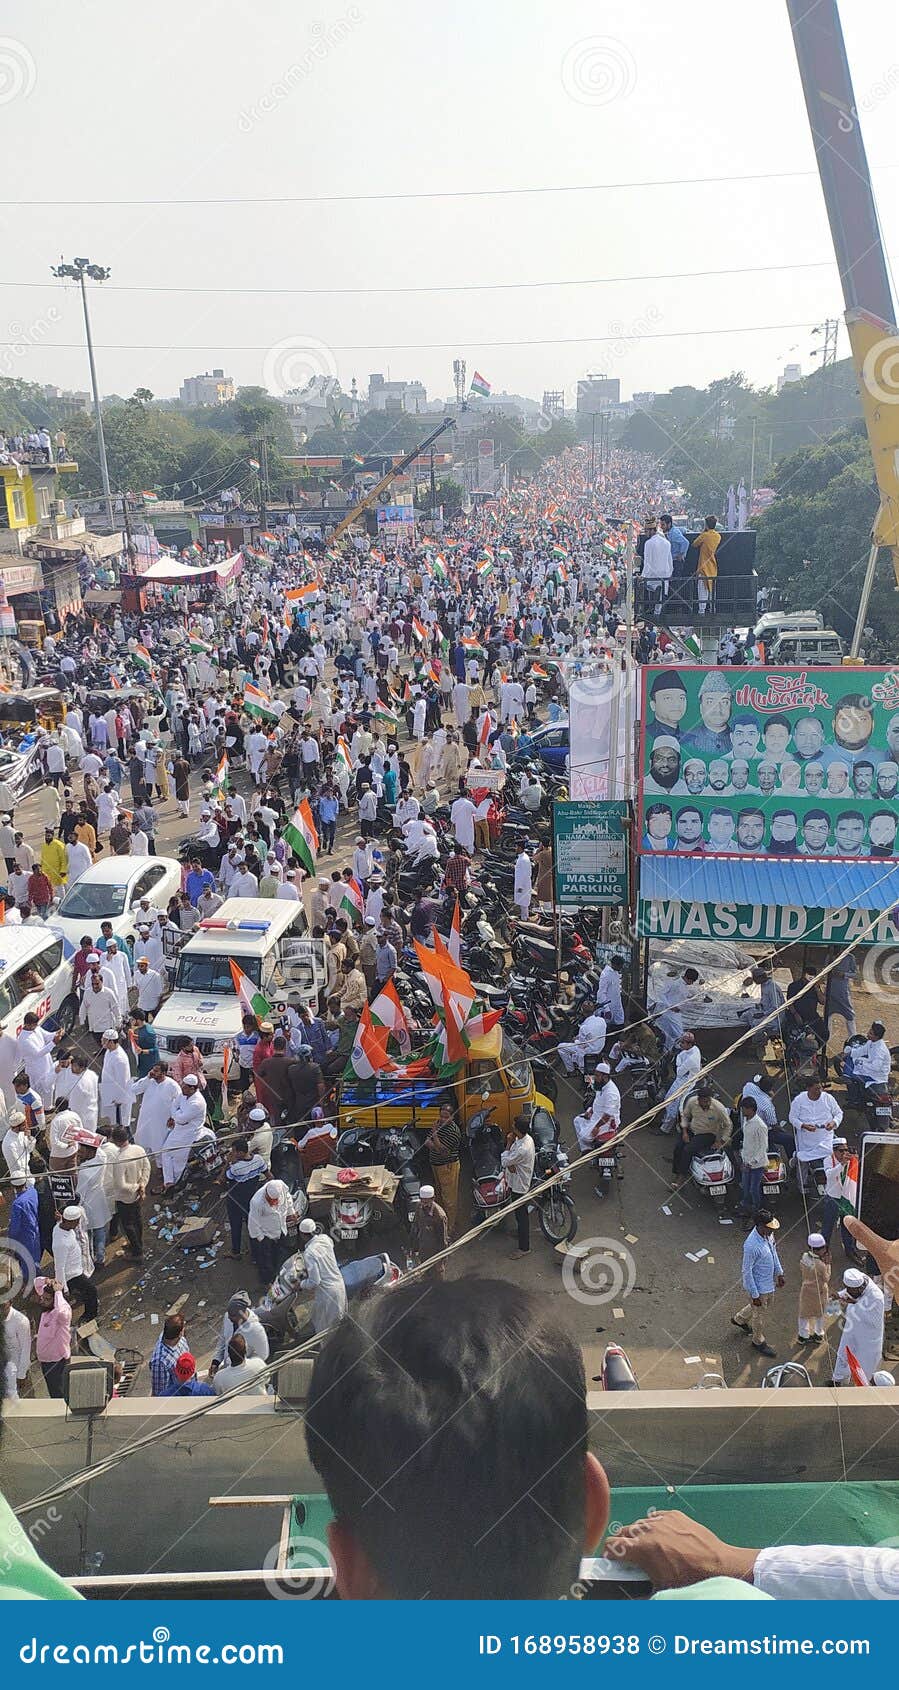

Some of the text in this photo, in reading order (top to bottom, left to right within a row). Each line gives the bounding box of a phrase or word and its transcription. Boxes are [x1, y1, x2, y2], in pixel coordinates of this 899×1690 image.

[767, 672, 817, 693] Eid
[736, 684, 832, 714] Mubarak
[566, 874, 618, 883] MASJID
[562, 884, 622, 893] PARKING
[650, 900, 807, 938] MASJID
[176, 1015, 219, 1025] POLICE
